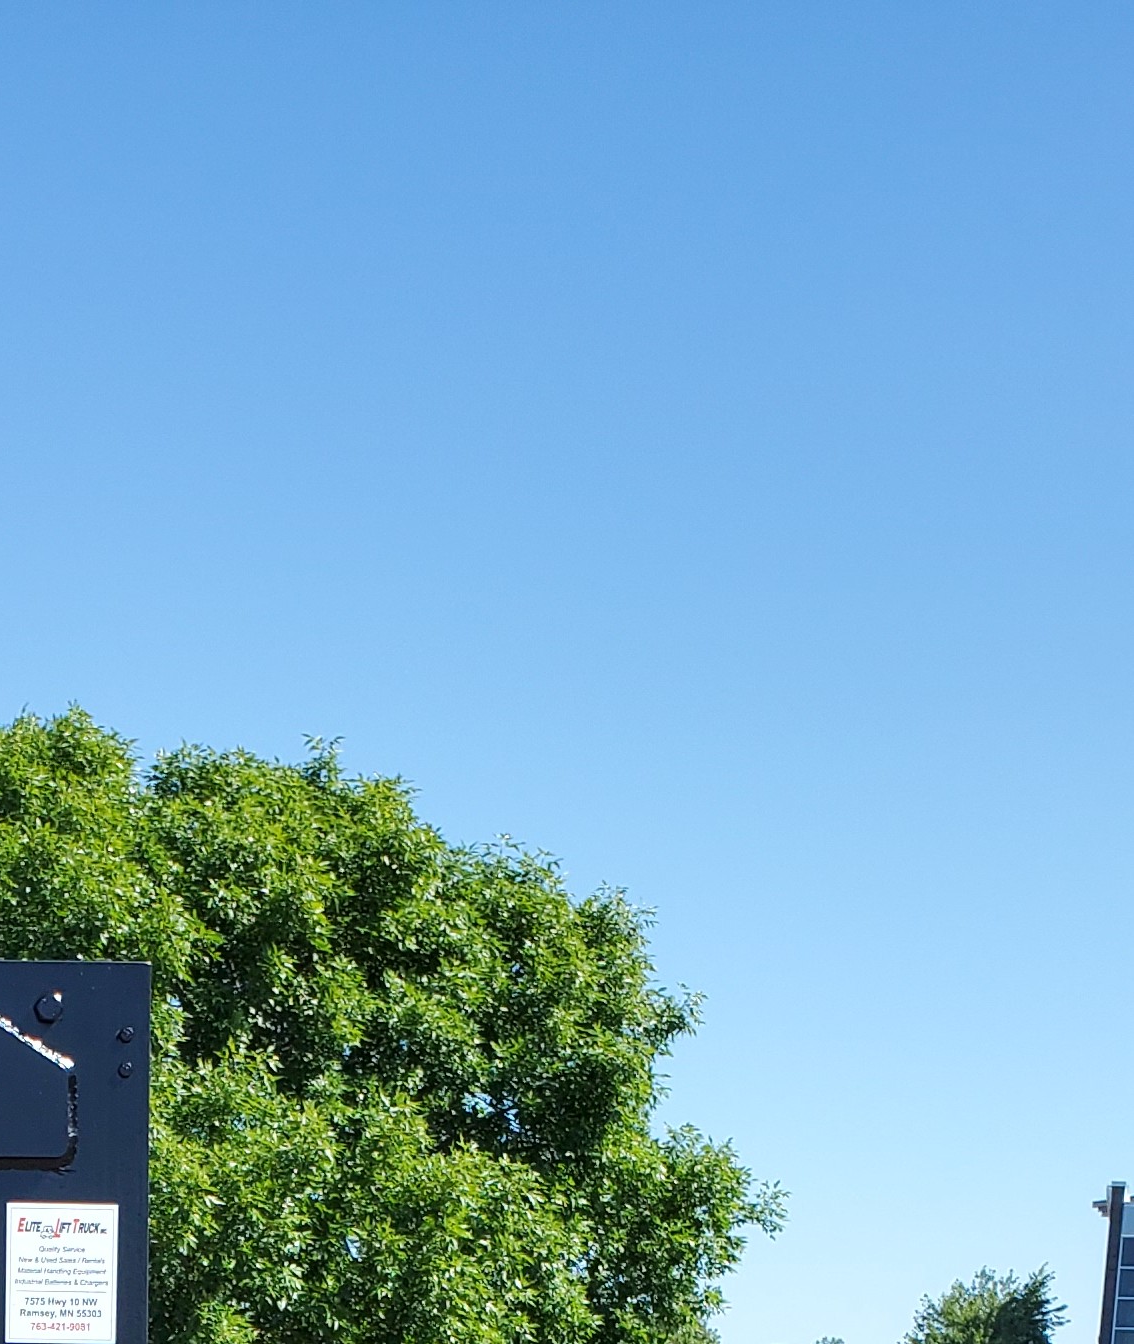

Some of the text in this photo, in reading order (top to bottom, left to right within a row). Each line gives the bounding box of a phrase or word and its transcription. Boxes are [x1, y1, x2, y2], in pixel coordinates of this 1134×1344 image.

[72, 1218, 101, 1235] TRUCK
[38, 1245, 61, 1254] Quality
[24, 1297, 98, 1308] 7575 Hwy 10 NW
[19, 1308, 102, 1319] Ramsey, MN 55303
